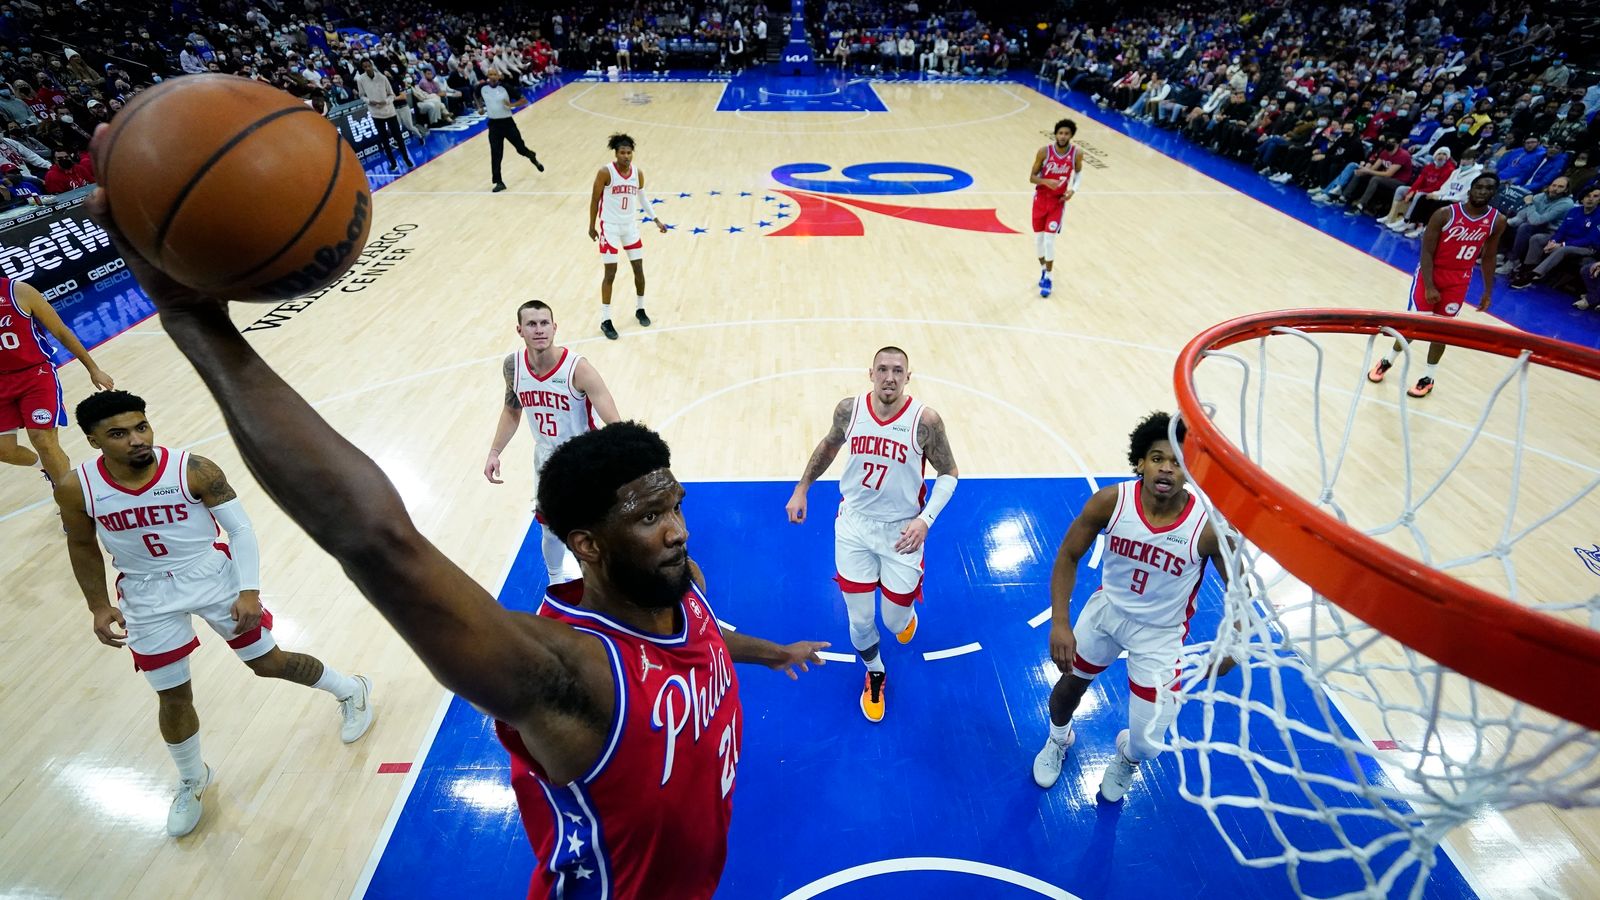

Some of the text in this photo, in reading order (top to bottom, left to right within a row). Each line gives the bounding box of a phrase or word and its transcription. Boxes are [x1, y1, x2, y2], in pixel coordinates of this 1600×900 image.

[17, 213, 35, 223] GEICO
[36, 207, 54, 216] GEICO
[55, 201, 72, 211] GEICO
[621, 196, 629, 210] 0
[1443, 225, 1487, 243] Phila
[1455, 245, 1477, 260] 18
[87, 258, 126, 281] GEICO
[341, 248, 415, 292] CENTER
[0, 332, 20, 350] 0
[519, 390, 570, 411] ROCKETS
[534, 412, 557, 437] 25
[850, 435, 908, 464] ROCKETS
[861, 461, 888, 491] 27
[153, 488, 179, 497] MONEY
[97, 503, 188, 532] ROCKETS
[142, 533, 169, 557] 6
[1166, 536, 1188, 545] MONEY
[1110, 535, 1187, 577] ROCKETS
[1130, 568, 1150, 595] 9
[650, 642, 731, 787] Phila
